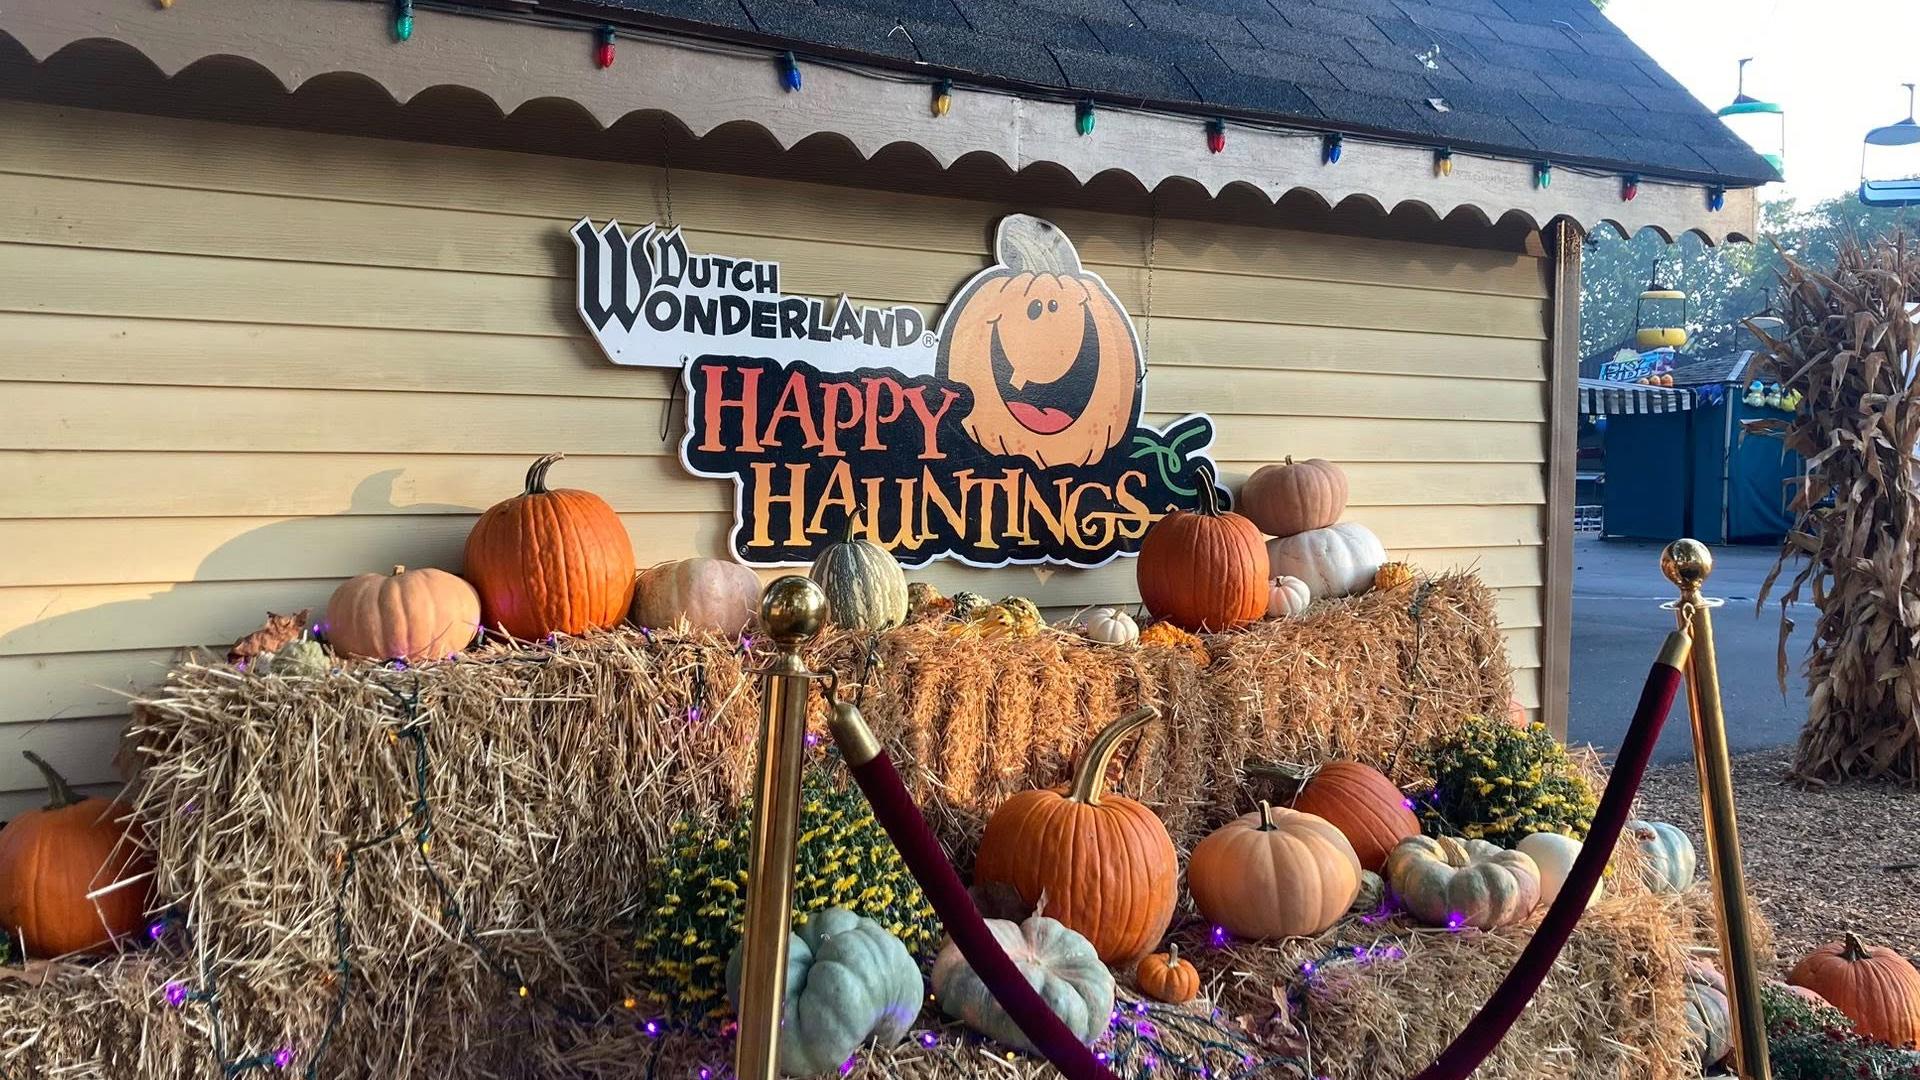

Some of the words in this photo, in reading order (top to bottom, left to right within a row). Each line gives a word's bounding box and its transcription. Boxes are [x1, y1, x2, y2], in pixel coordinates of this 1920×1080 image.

[575, 221, 924, 349] WONDERLAND
[653, 232, 778, 293] DUTCH
[698, 362, 961, 461] HAPPY
[1607, 358, 1645, 374] SKY
[746, 459, 1166, 551] HAUNTINGS
